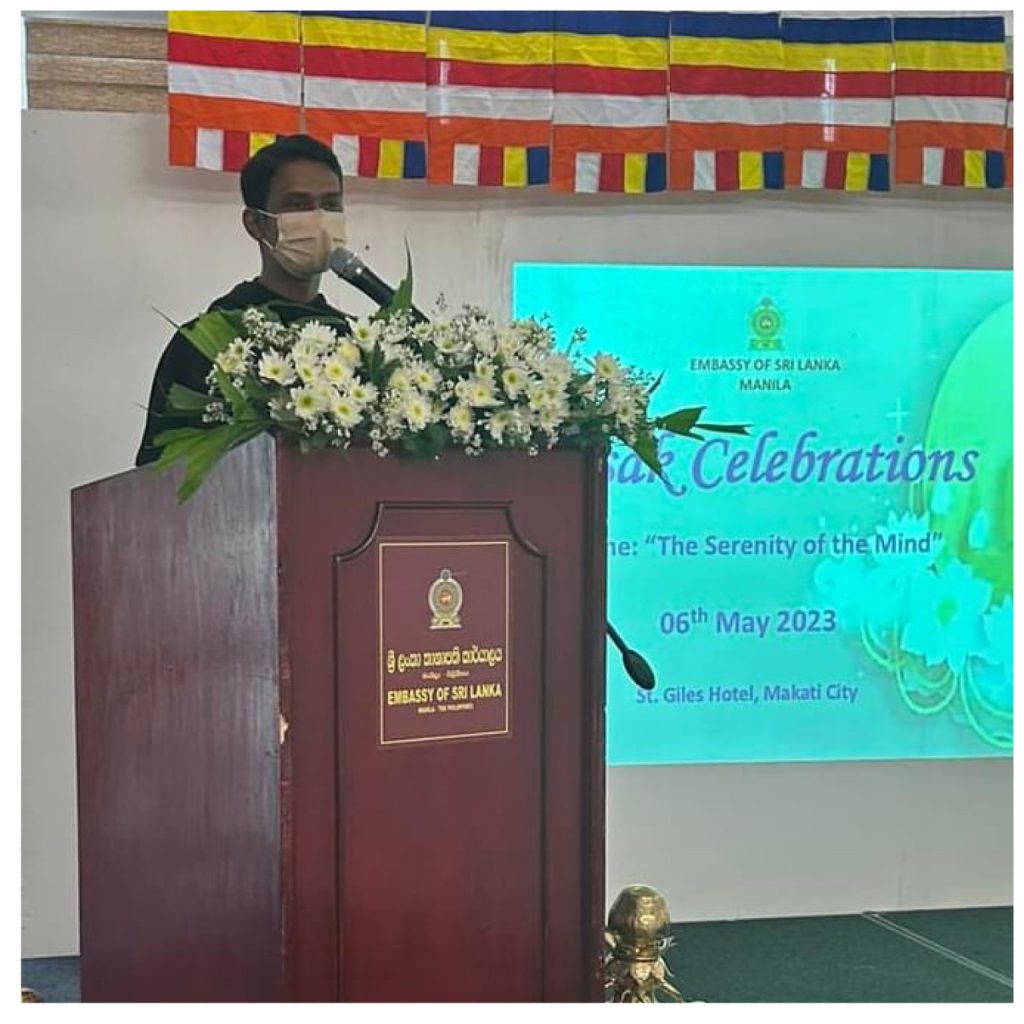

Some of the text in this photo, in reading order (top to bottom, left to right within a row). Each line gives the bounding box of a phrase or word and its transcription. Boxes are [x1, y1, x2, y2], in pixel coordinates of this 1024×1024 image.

[690, 358, 841, 372] EMBASSY OF SRI LANKA
[739, 378, 792, 392] MANILA
[692, 430, 980, 490] Celebrations
[705, 533, 797, 559] Serenity
[803, 533, 827, 555] of
[832, 533, 868, 555] the
[660, 607, 837, 638] 06th May 2023
[388, 682, 503, 705] EMBASSY OF SRI LANKA
[663, 687, 704, 703] Giles
[709, 686, 760, 704] Hotel,
[764, 684, 822, 702] Makati
[826, 682, 859, 704] City
